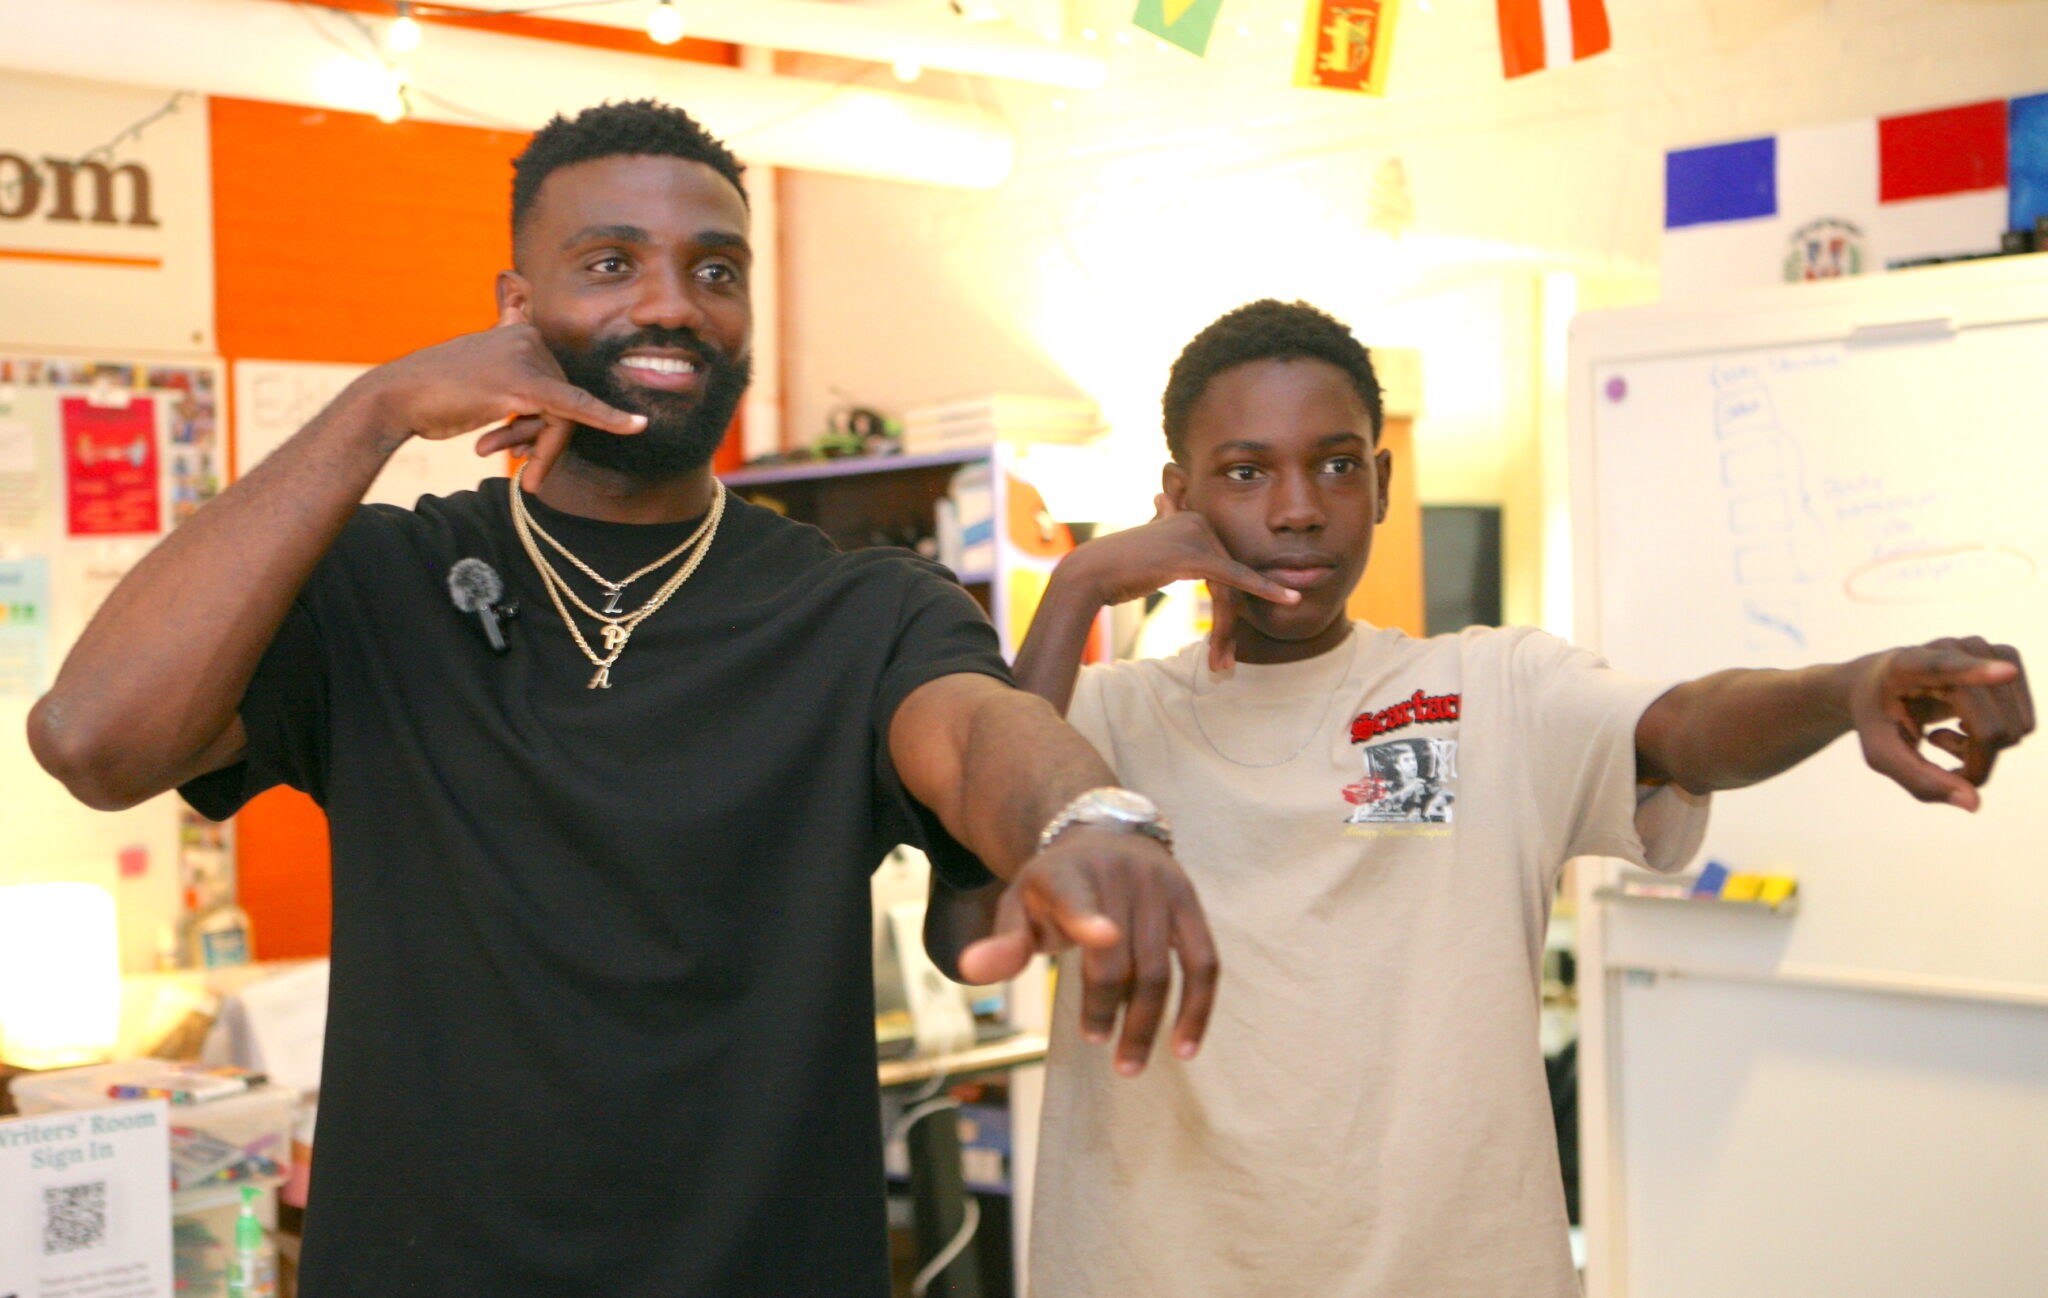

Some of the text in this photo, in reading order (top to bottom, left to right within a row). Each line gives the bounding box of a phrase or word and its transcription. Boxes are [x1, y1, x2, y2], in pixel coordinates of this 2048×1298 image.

[0, 152, 160, 227] om
[601, 591, 623, 614] Z
[599, 625, 627, 650] P
[586, 667, 612, 690] A
[1350, 689, 1461, 744] Scarfac
[91, 1112, 156, 1135] Room
[31, 1141, 114, 1171] Sign In
